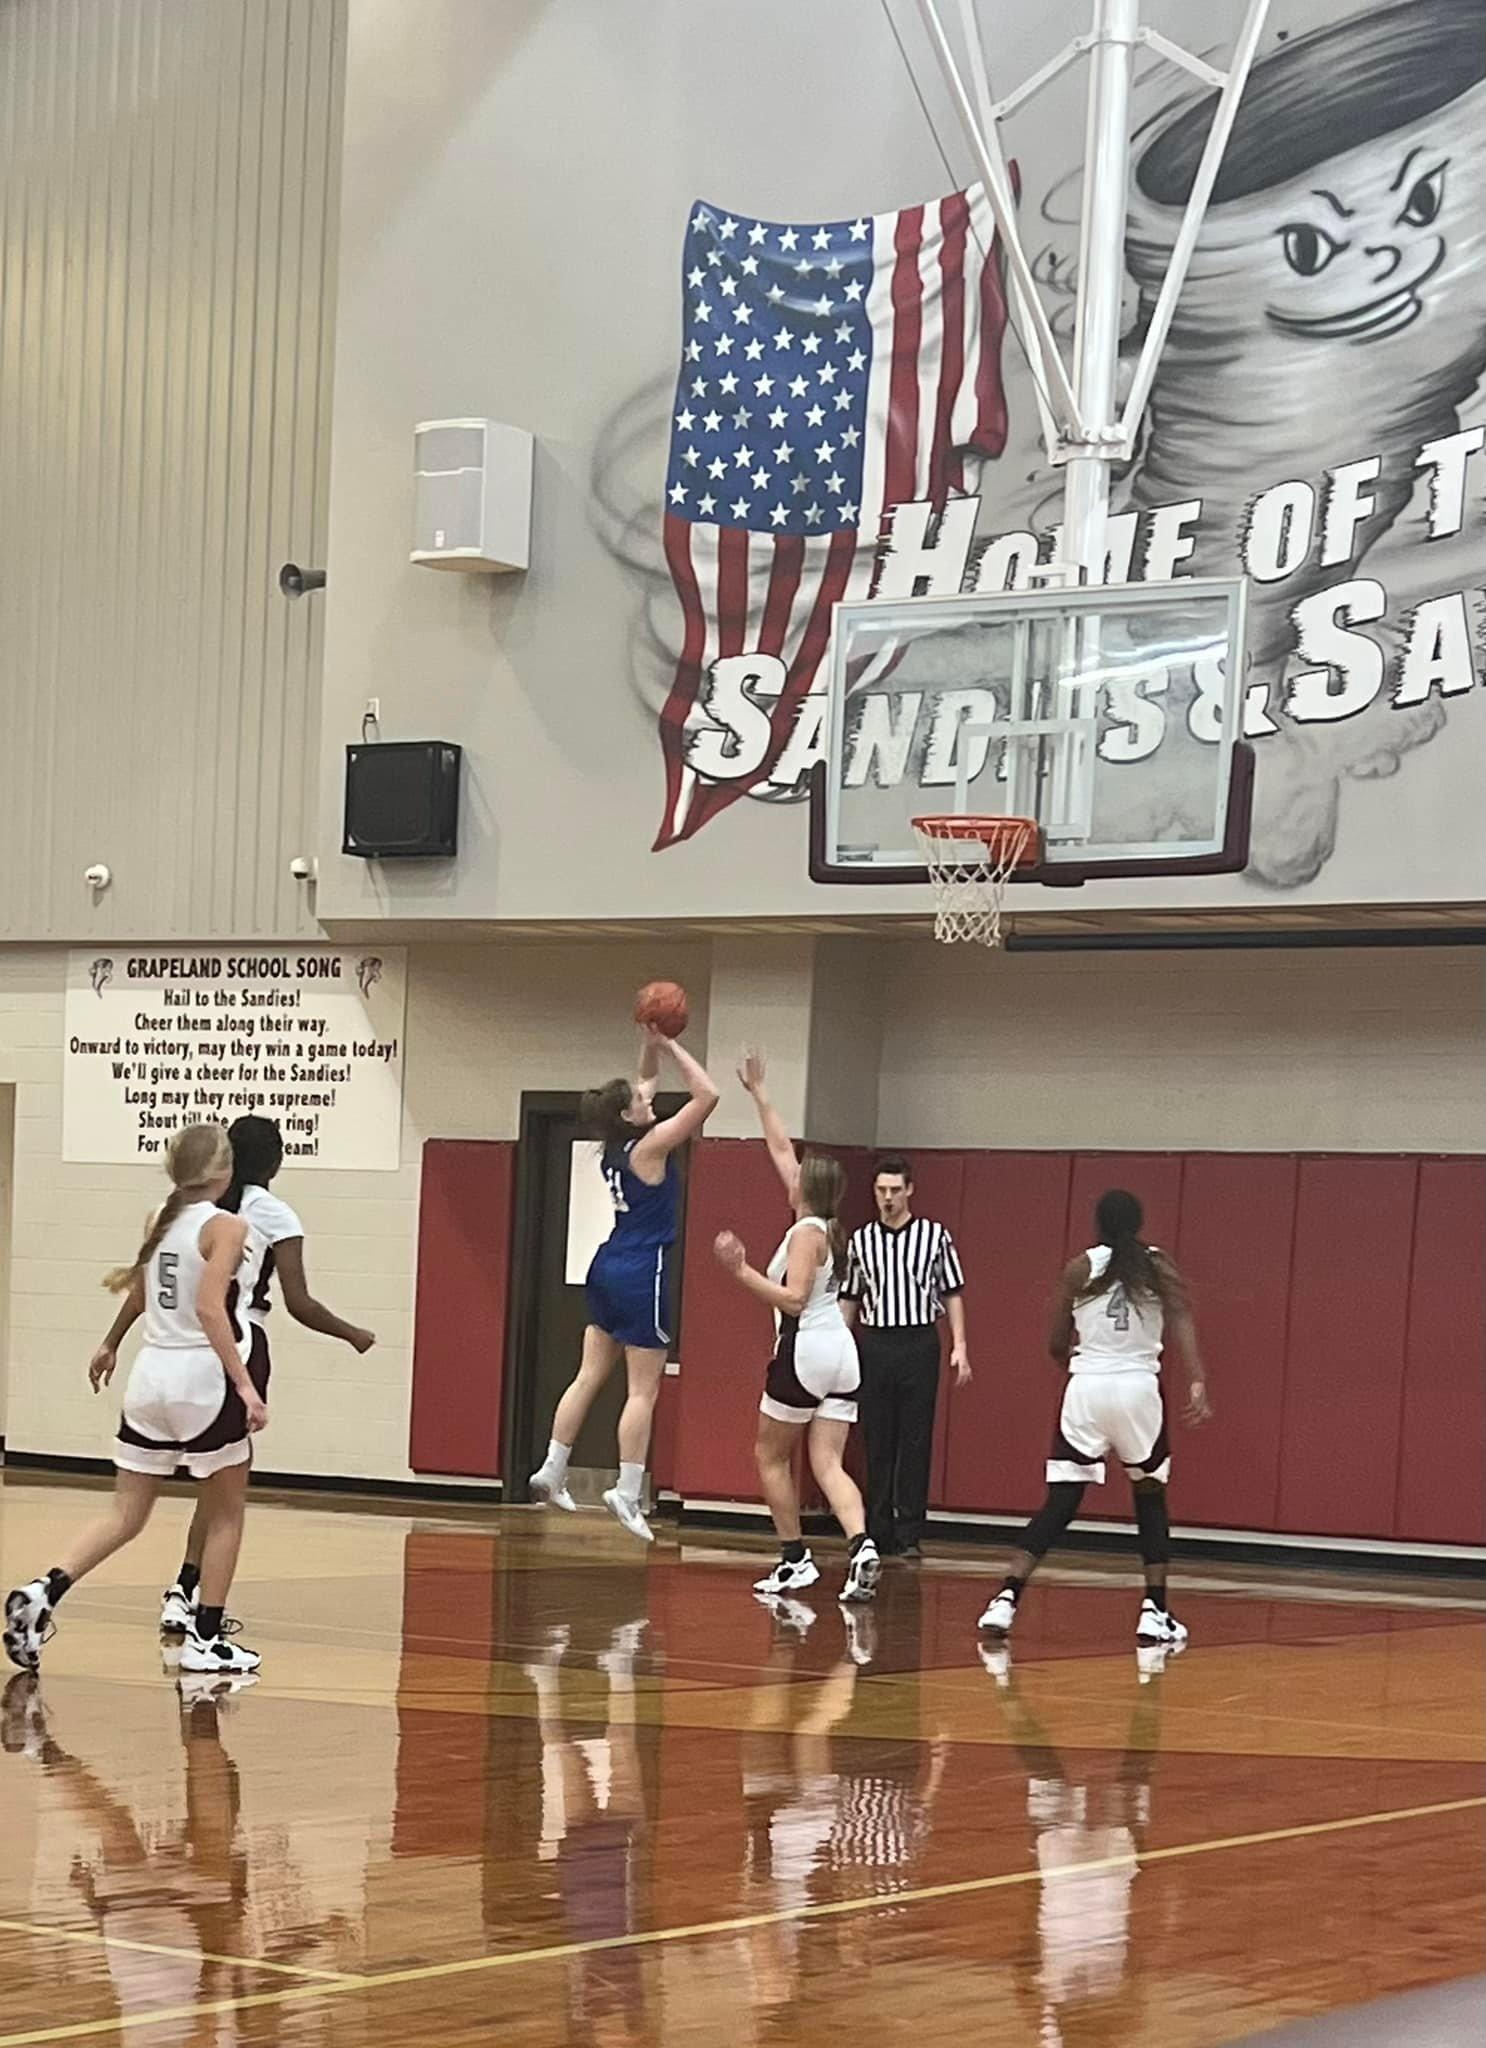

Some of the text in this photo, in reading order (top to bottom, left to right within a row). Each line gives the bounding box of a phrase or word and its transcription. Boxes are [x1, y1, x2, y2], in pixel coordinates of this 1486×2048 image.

[1238, 454, 1382, 584] OF
[1414, 425, 1486, 542] T
[683, 650, 1172, 794] SANDS
[1282, 577, 1486, 726] SA
[127, 957, 341, 978] GRAPELAND SCHOOL SONG
[164, 989, 300, 1007] Hail to the Sandies!
[135, 1013, 329, 1037] Cheer them along their way.
[70, 1036, 397, 1062] Onward to victory, may they win a game today!
[151, 1063, 179, 1085] give
[184, 1068, 192, 1080] a
[197, 1063, 234, 1080] cheer
[239, 1063, 258, 1081] for
[264, 1064, 285, 1081] the
[291, 1064, 350, 1082] Sandies!
[125, 1087, 335, 1111] Long may they reign supreme!
[139, 1112, 177, 1128] Shout
[286, 1113, 318, 1135] ring!
[138, 1135, 160, 1152] For
[284, 1138, 319, 1156] eam!
[158, 1252, 179, 1310] 5
[1106, 1281, 1129, 1331] 4
